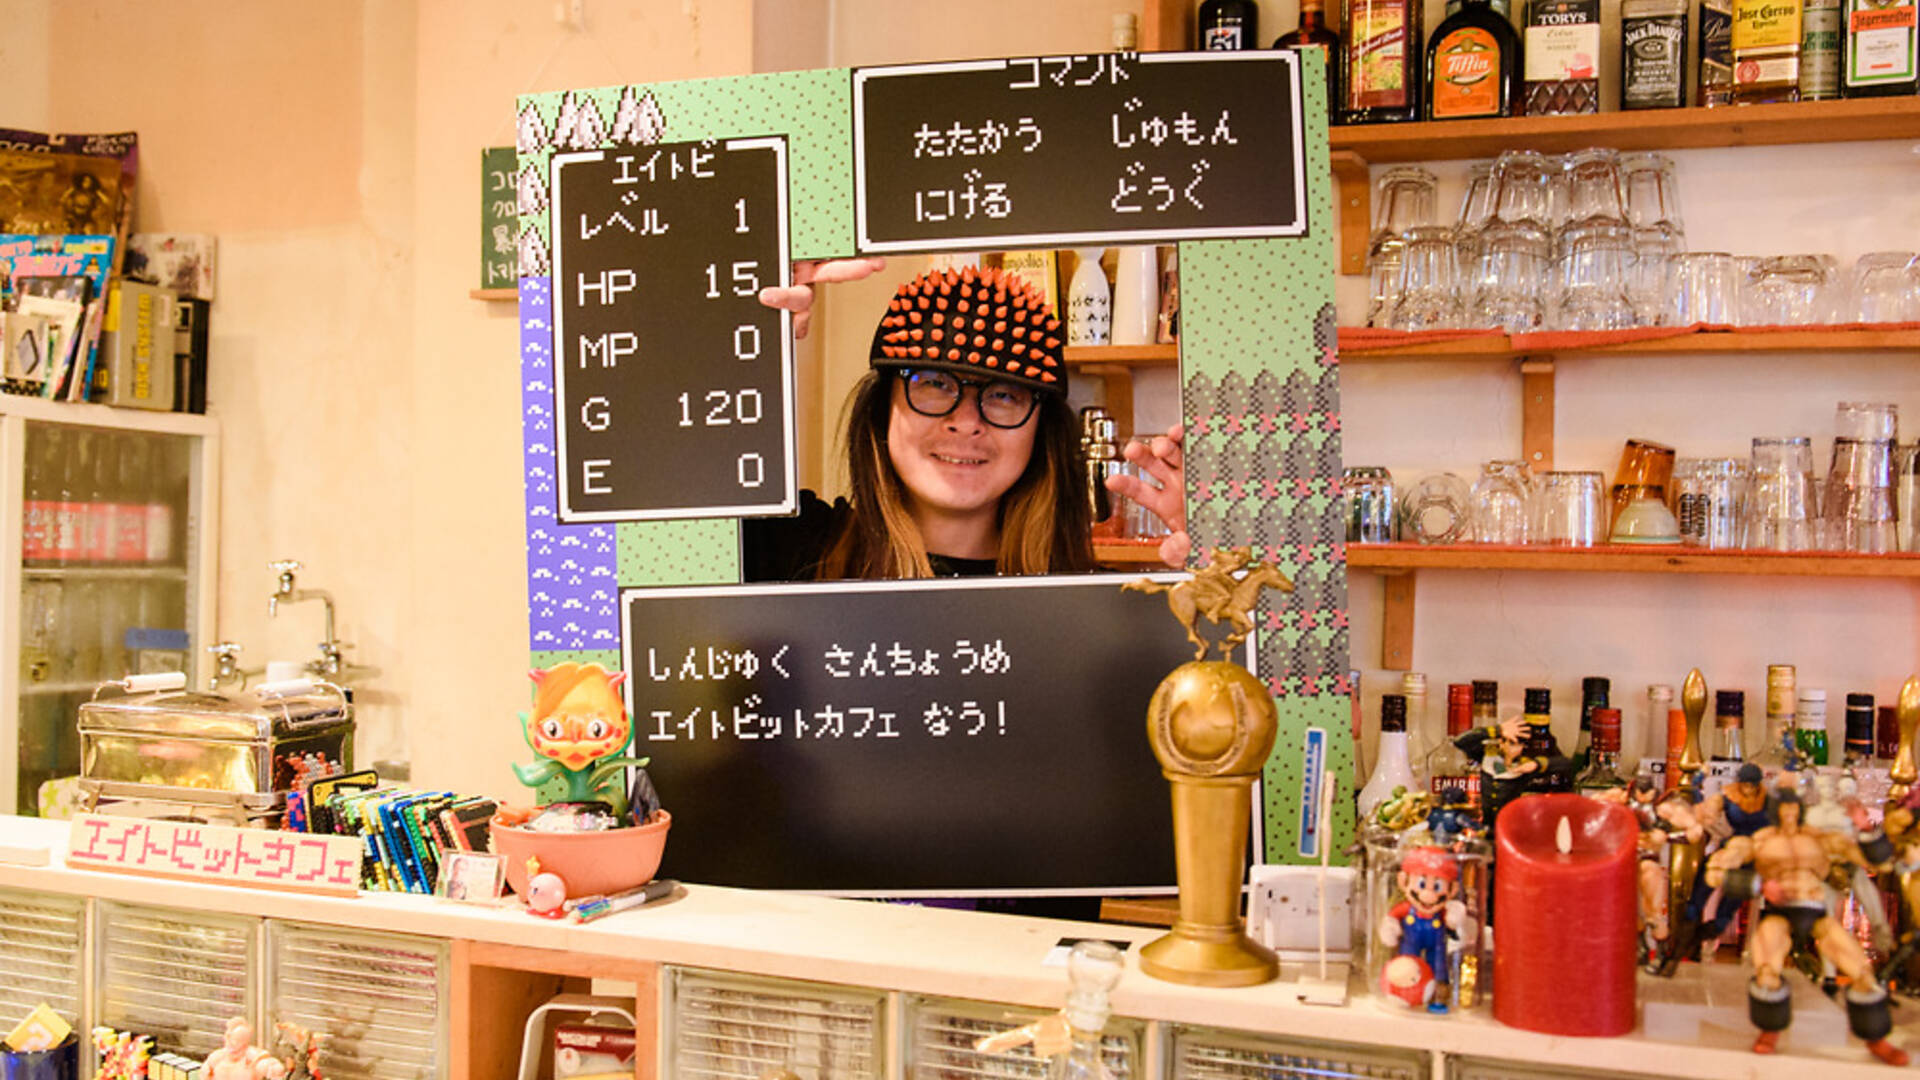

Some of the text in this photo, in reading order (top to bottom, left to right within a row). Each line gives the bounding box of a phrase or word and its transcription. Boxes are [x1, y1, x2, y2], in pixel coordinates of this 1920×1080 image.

[1538, 12, 1587, 26] TORYS
[1009, 51, 1138, 90] コマンド
[1447, 54, 1490, 75] Tiffin
[914, 97, 1239, 159] たたかう じゅもん
[612, 139, 718, 185] エイトビ
[915, 159, 1210, 222] にげる どうぐ
[580, 191, 750, 240] レベル 1
[577, 261, 760, 307] HP 15
[578, 324, 761, 368] MP 0
[581, 388, 764, 431] G 120
[583, 453, 765, 496] E 0
[648, 639, 1011, 682] しんじゅく さんちょうめ
[648, 694, 901, 741] エイトビットカフェ
[71, 819, 354, 885] エイトビットカフェ
